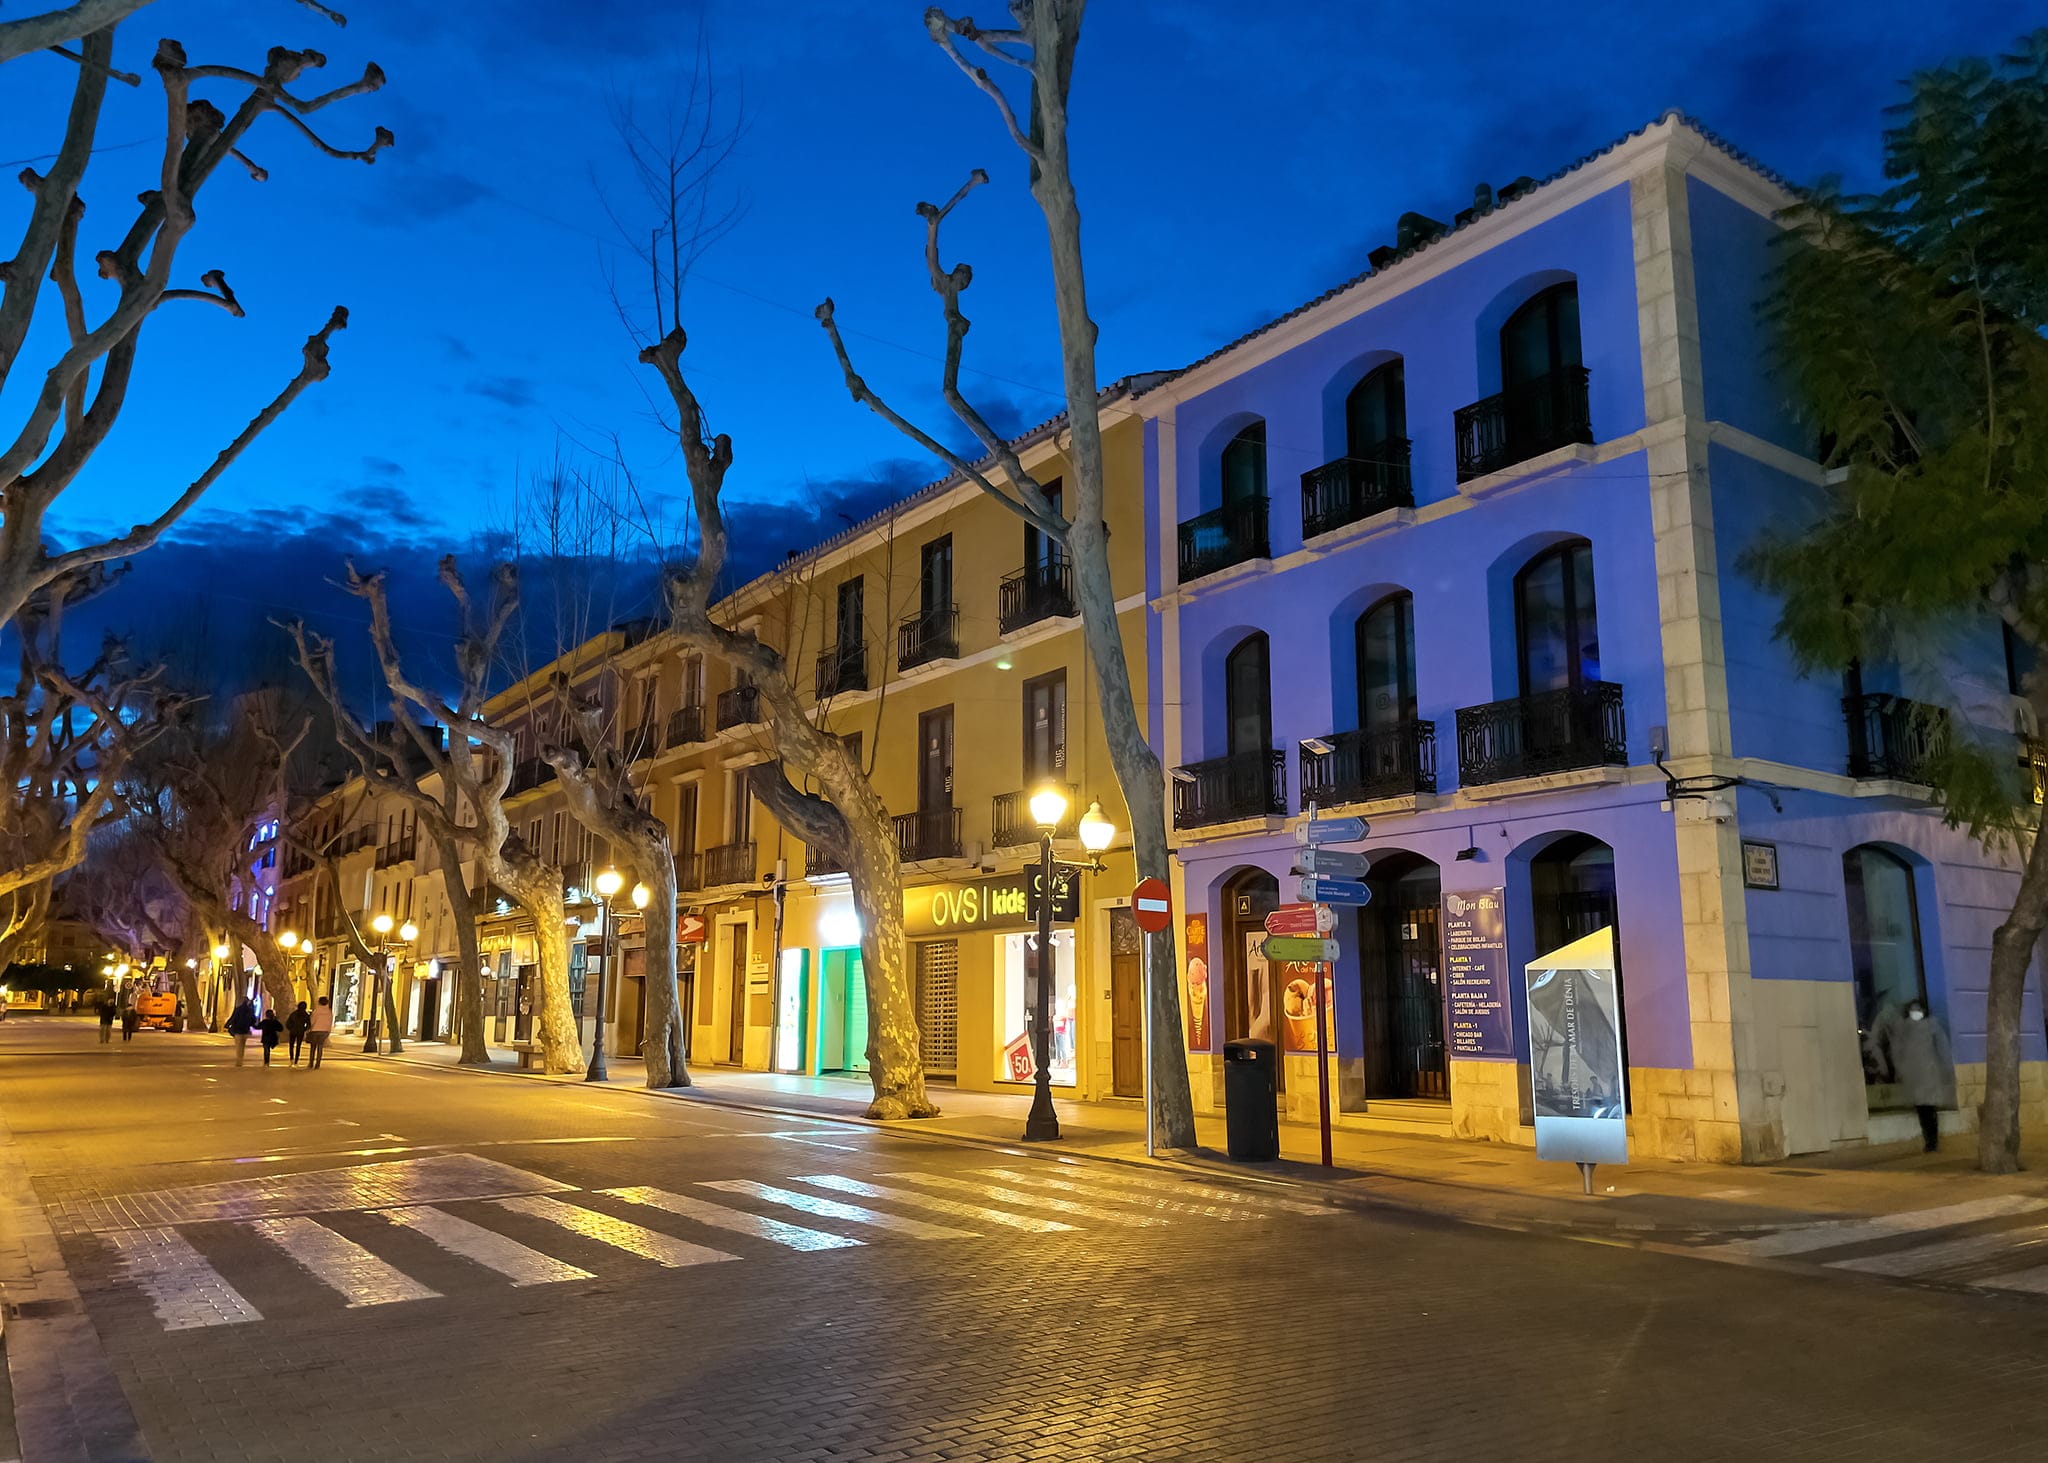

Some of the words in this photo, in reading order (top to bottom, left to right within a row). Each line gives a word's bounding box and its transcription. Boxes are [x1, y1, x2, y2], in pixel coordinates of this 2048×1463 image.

[932, 887, 978, 926] OVS
[992, 887, 1026, 915] kids
[1457, 900, 1476, 911] Mon
[1478, 898, 1499, 909] Blau
[1566, 1007, 1575, 1020] DE
[1567, 1022, 1576, 1043] MAR
